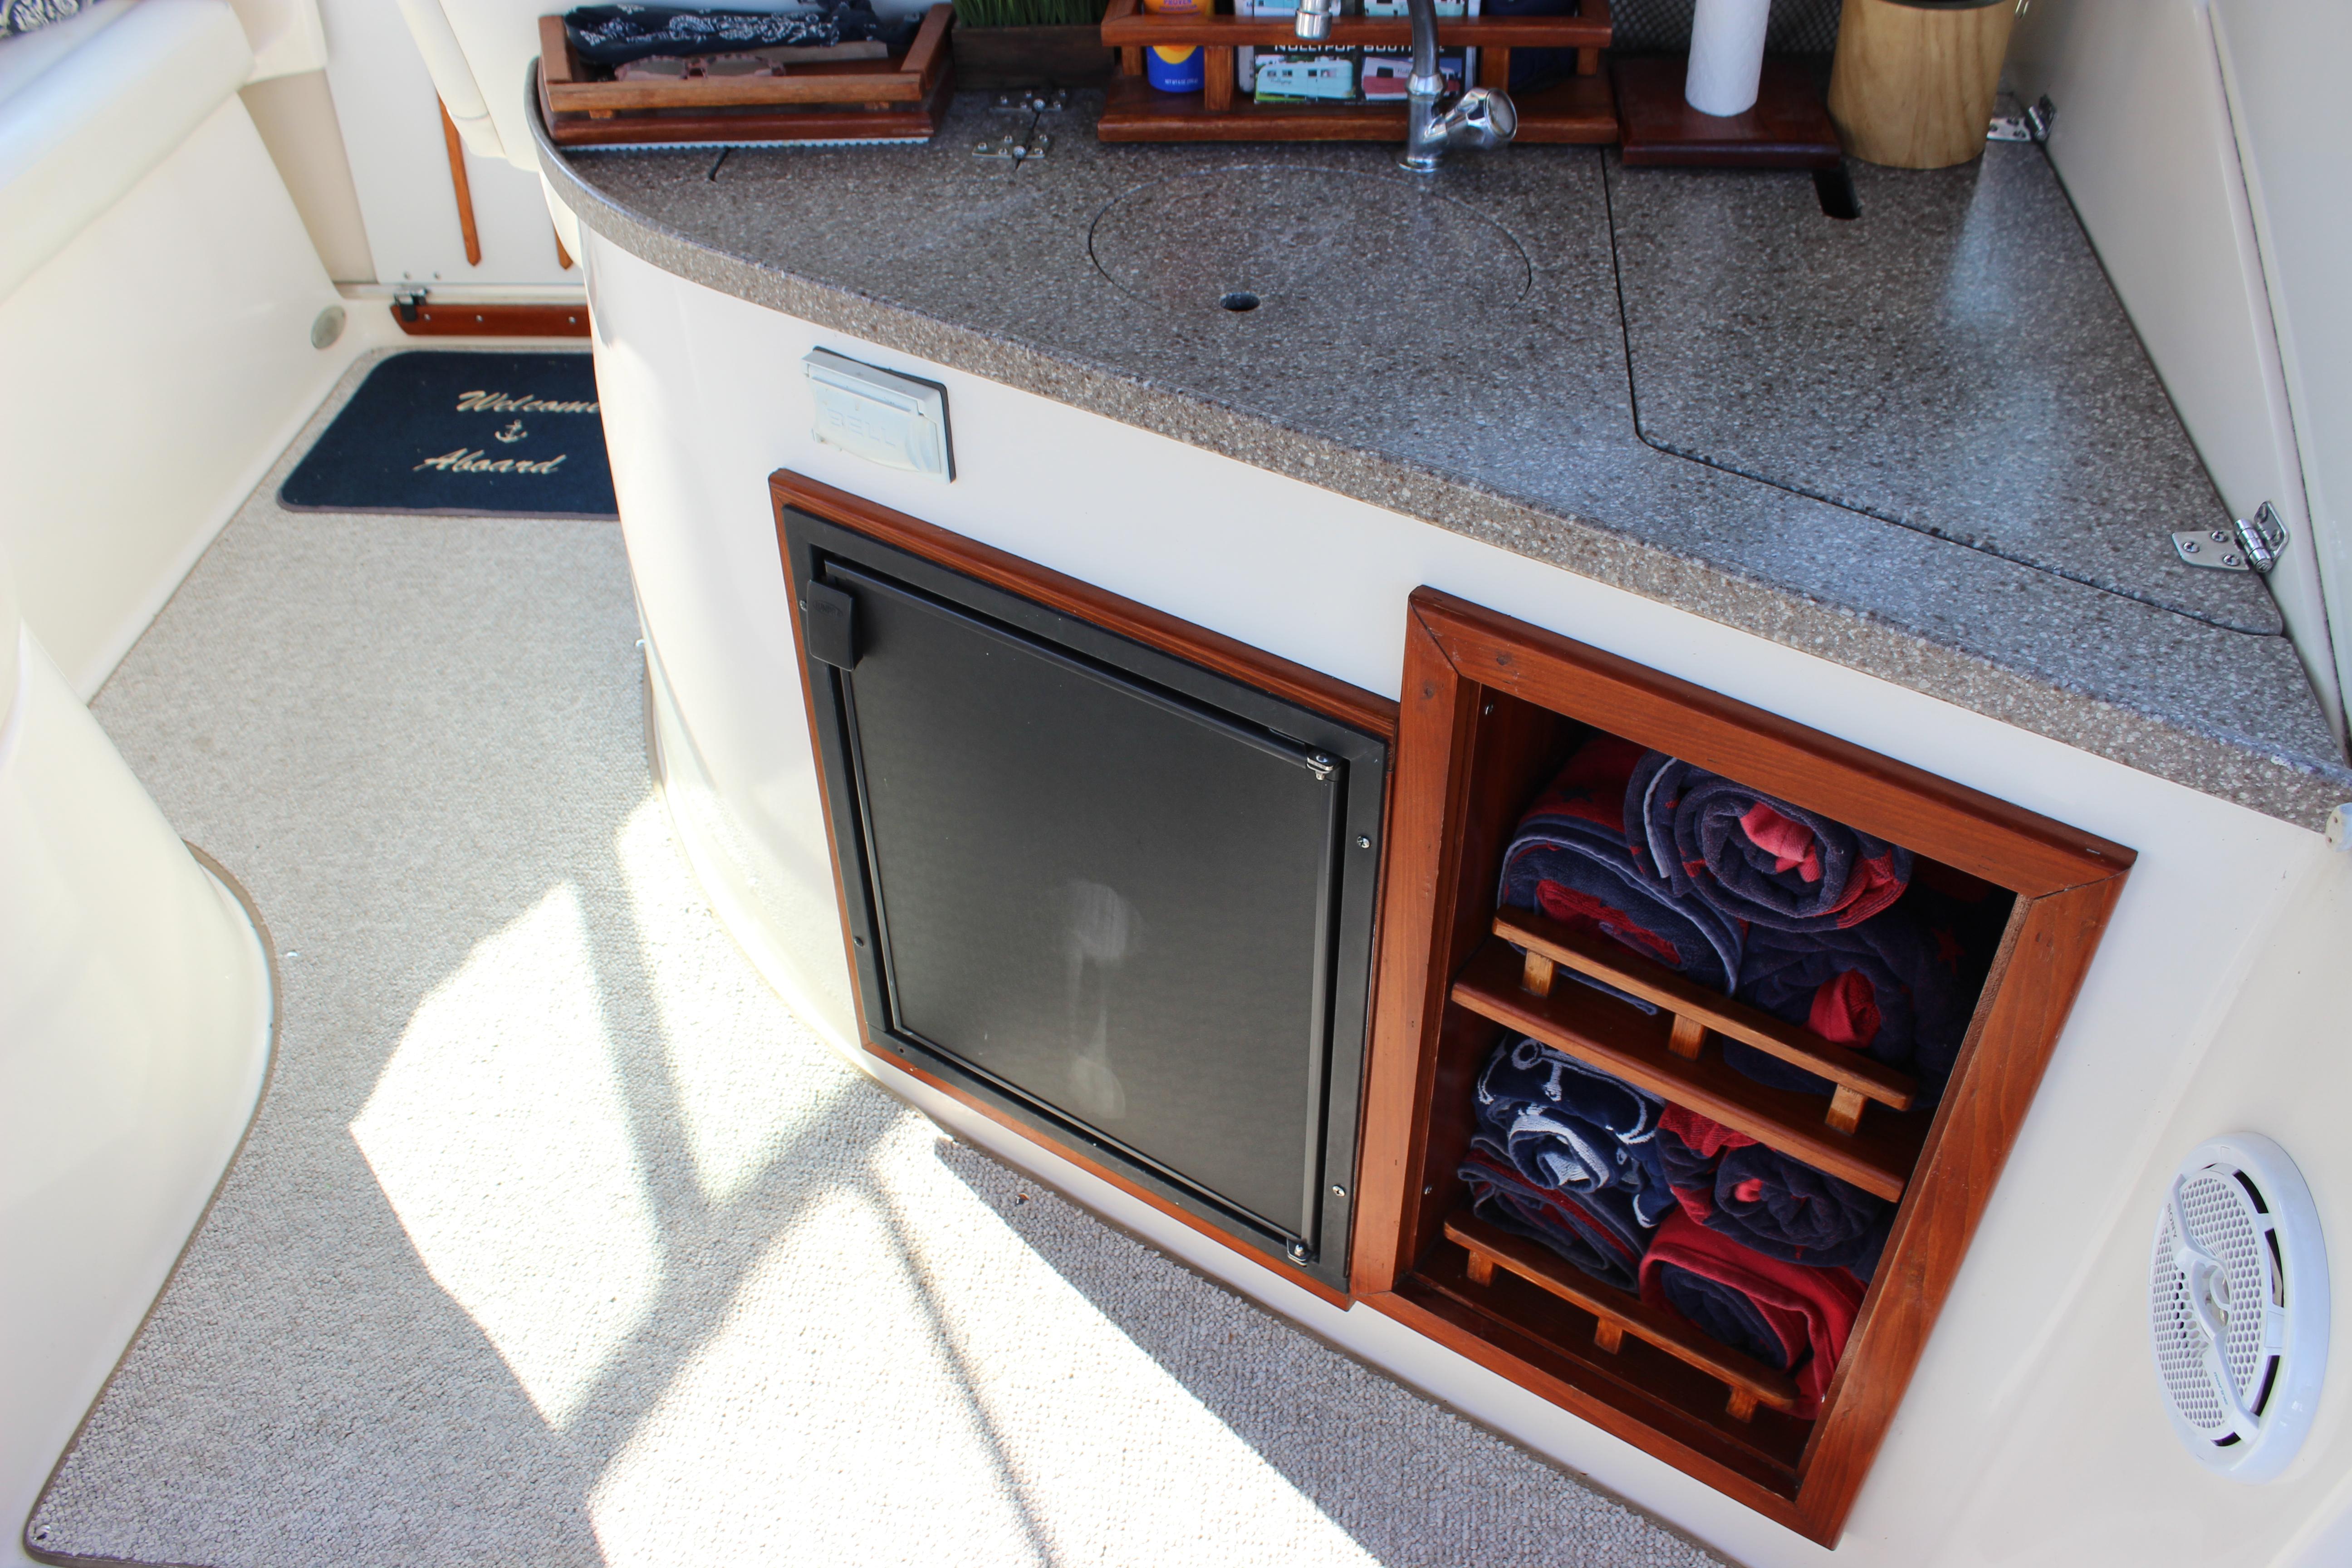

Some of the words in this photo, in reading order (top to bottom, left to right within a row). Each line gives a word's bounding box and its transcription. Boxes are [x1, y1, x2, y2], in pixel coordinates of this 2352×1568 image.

[456, 390, 599, 413] Welcome
[826, 408, 897, 448] BELL
[413, 448, 567, 474] Aboard
[2167, 1203, 2178, 1239] SONY
[2214, 1372, 2228, 1405] marine
